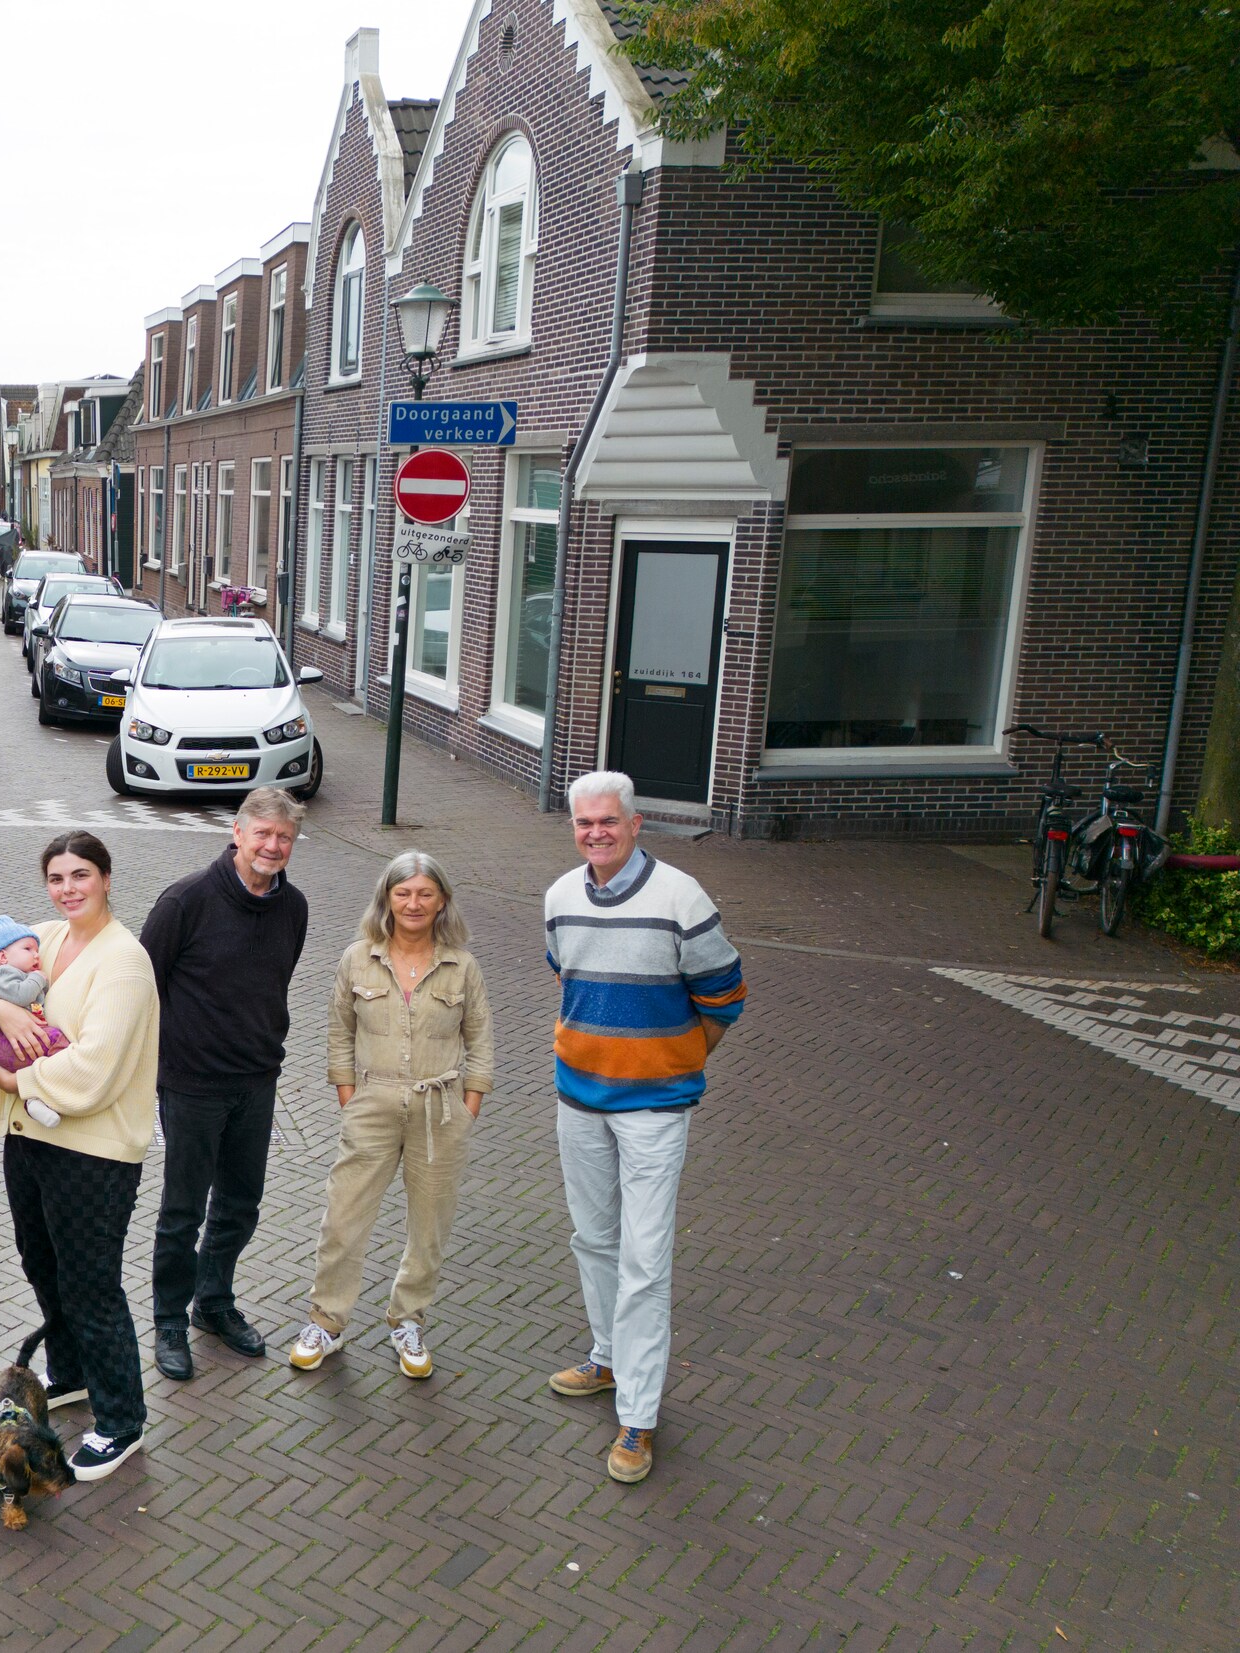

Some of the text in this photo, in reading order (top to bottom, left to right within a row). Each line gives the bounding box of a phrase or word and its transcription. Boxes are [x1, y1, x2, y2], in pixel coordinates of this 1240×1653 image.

[396, 406, 494, 423] Doorgaand
[425, 427, 494, 440] verkeer
[400, 528, 469, 545] uitgezonderd
[634, 668, 701, 679] zuiddijk 164
[197, 766, 245, 776] R-292-VV
